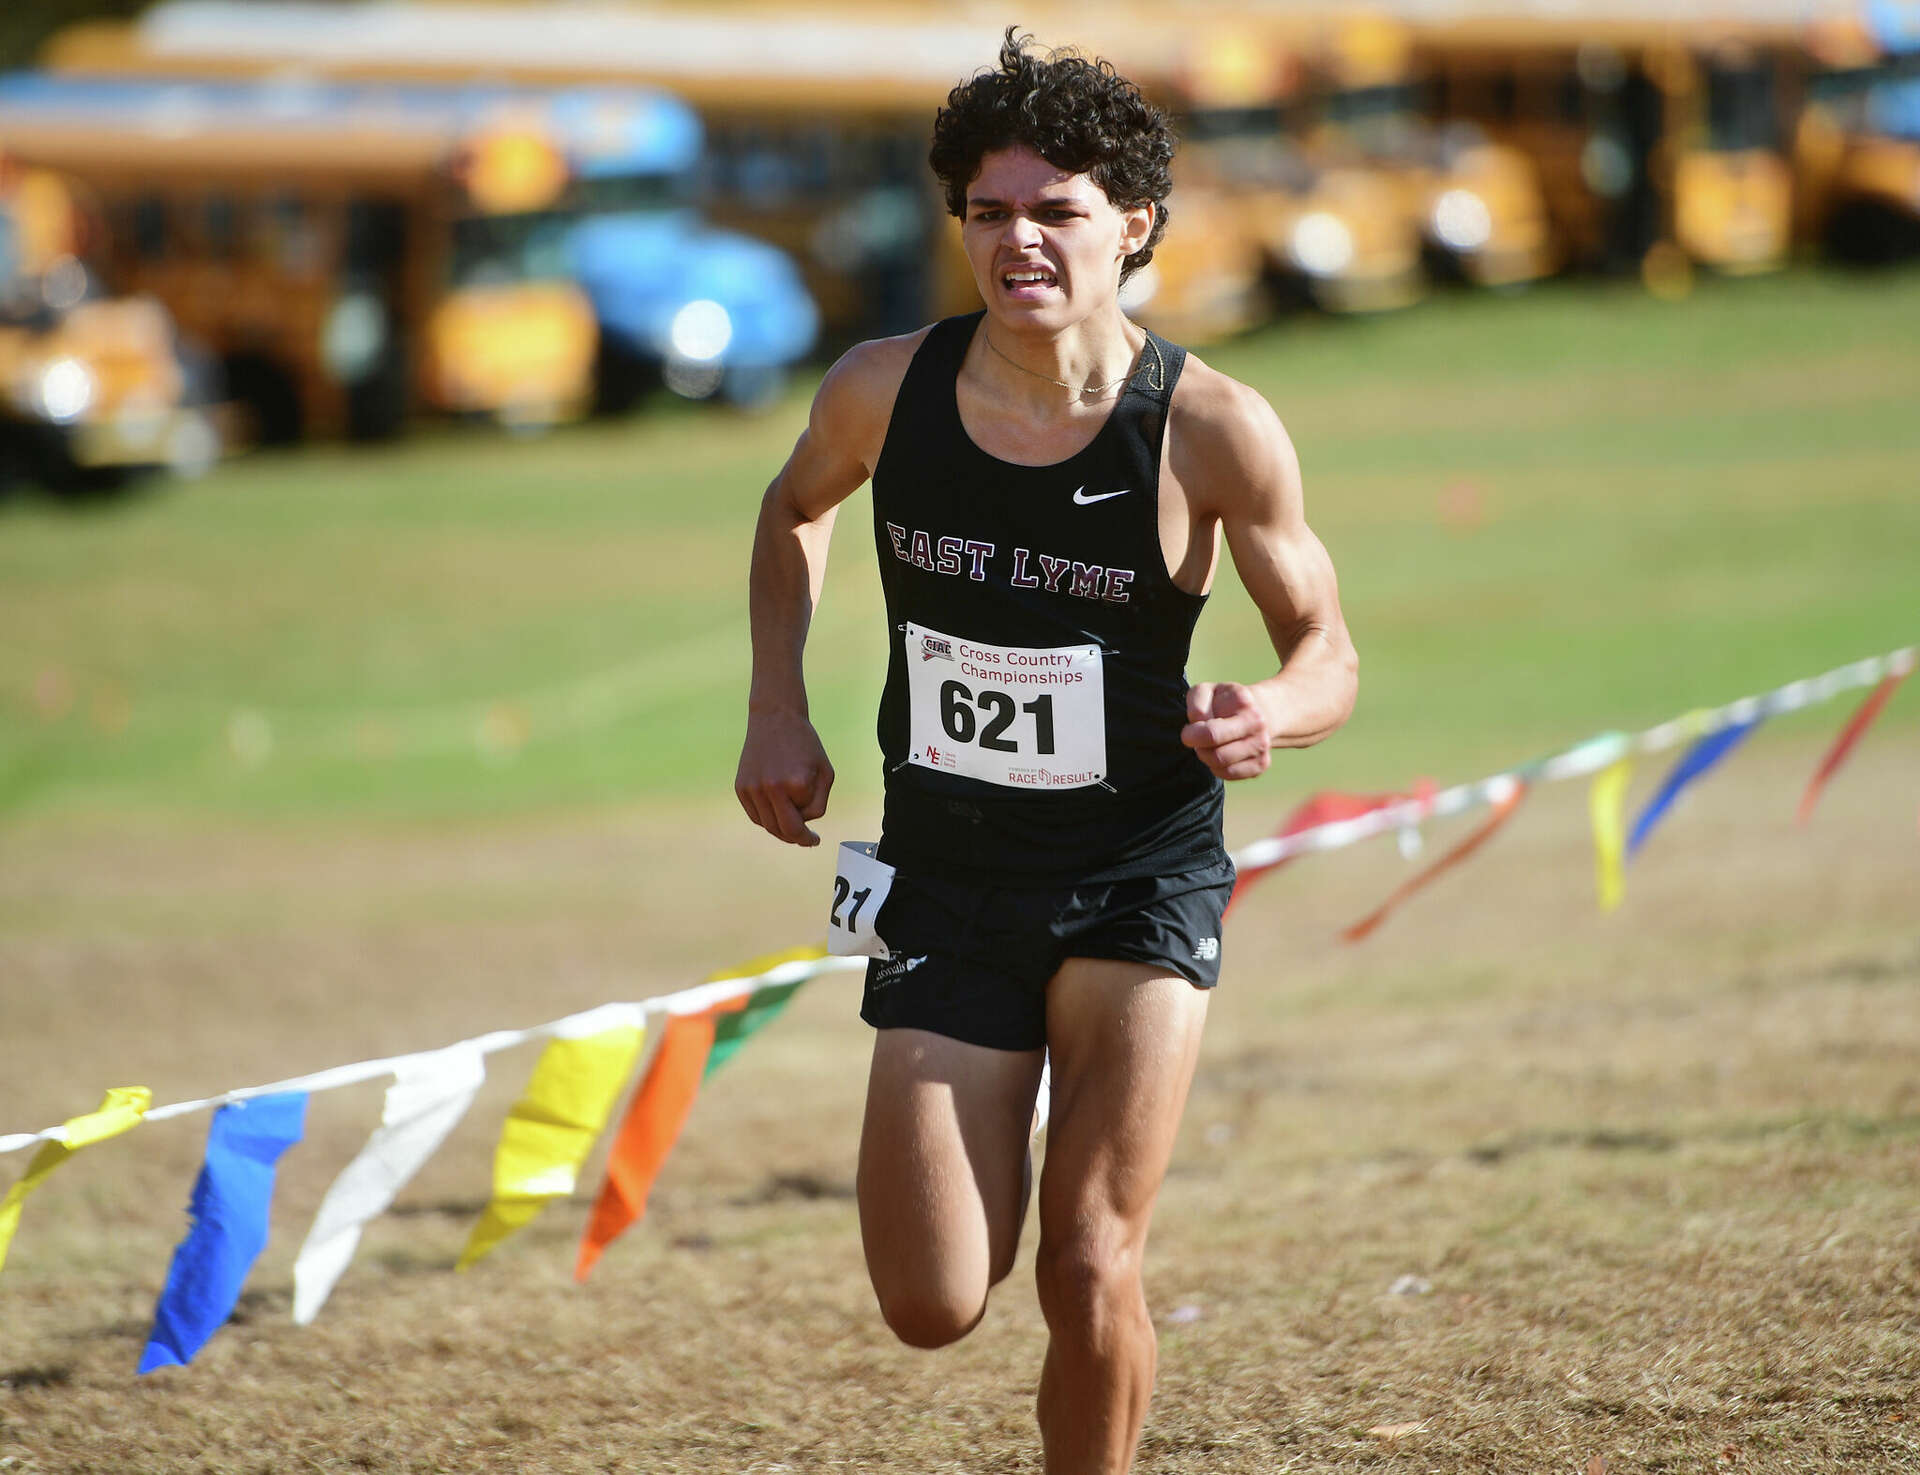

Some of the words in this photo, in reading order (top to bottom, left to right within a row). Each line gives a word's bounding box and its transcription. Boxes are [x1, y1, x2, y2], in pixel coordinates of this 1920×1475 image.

[886, 521, 995, 581] EAST
[1011, 548, 1135, 603] LYME
[959, 644, 1001, 664] Cross
[1006, 652, 1073, 668] Country
[961, 662, 1083, 685] Championships
[940, 679, 1056, 755] 621
[1008, 772, 1038, 784] RACE
[1052, 772, 1094, 785] RESULT
